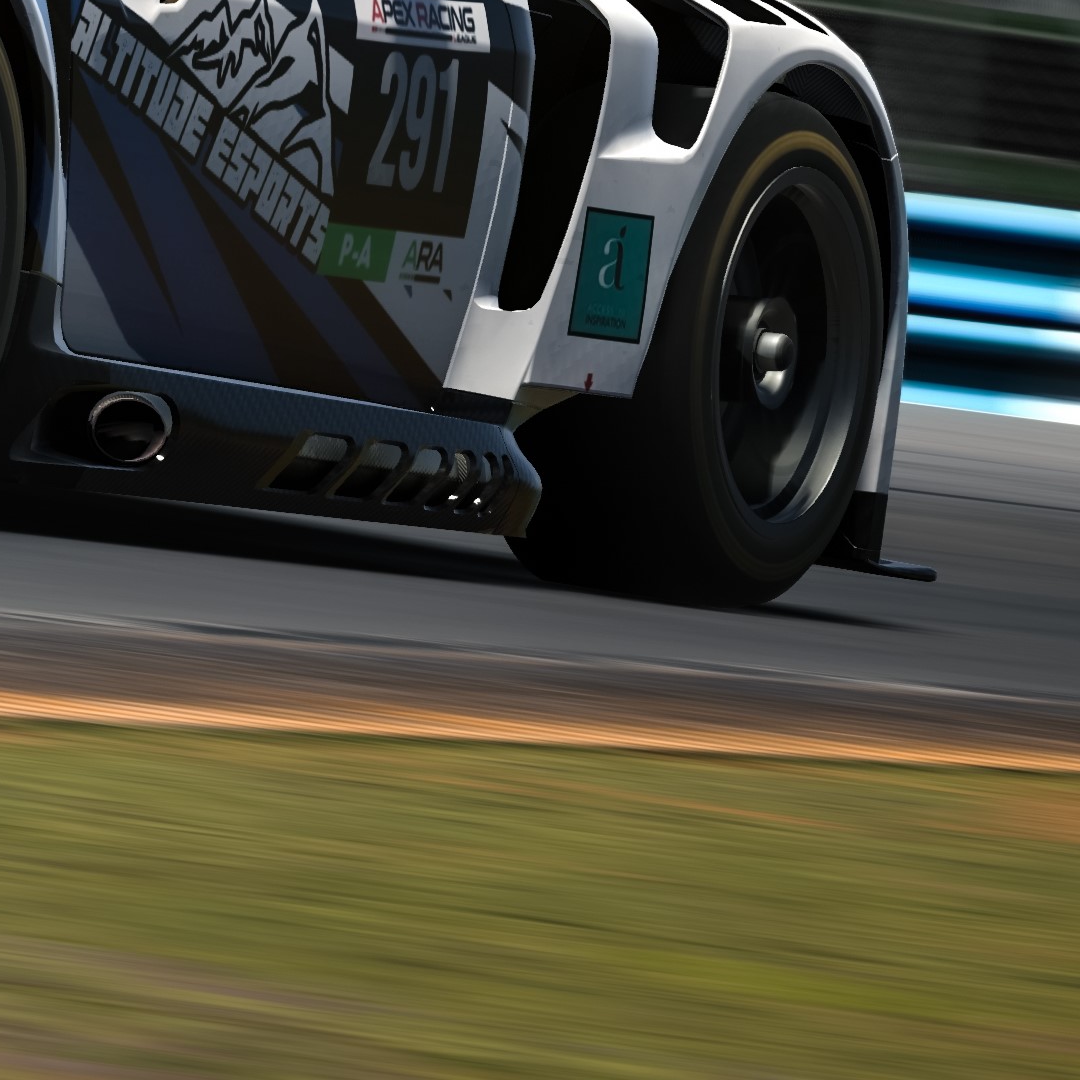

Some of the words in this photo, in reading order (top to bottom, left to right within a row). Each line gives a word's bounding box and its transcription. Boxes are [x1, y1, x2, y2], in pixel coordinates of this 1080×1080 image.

[416, 2, 476, 33] RACING
[365, 50, 460, 193] 291
[205, 115, 331, 265] ESPORTS
[401, 239, 444, 273] ARA
